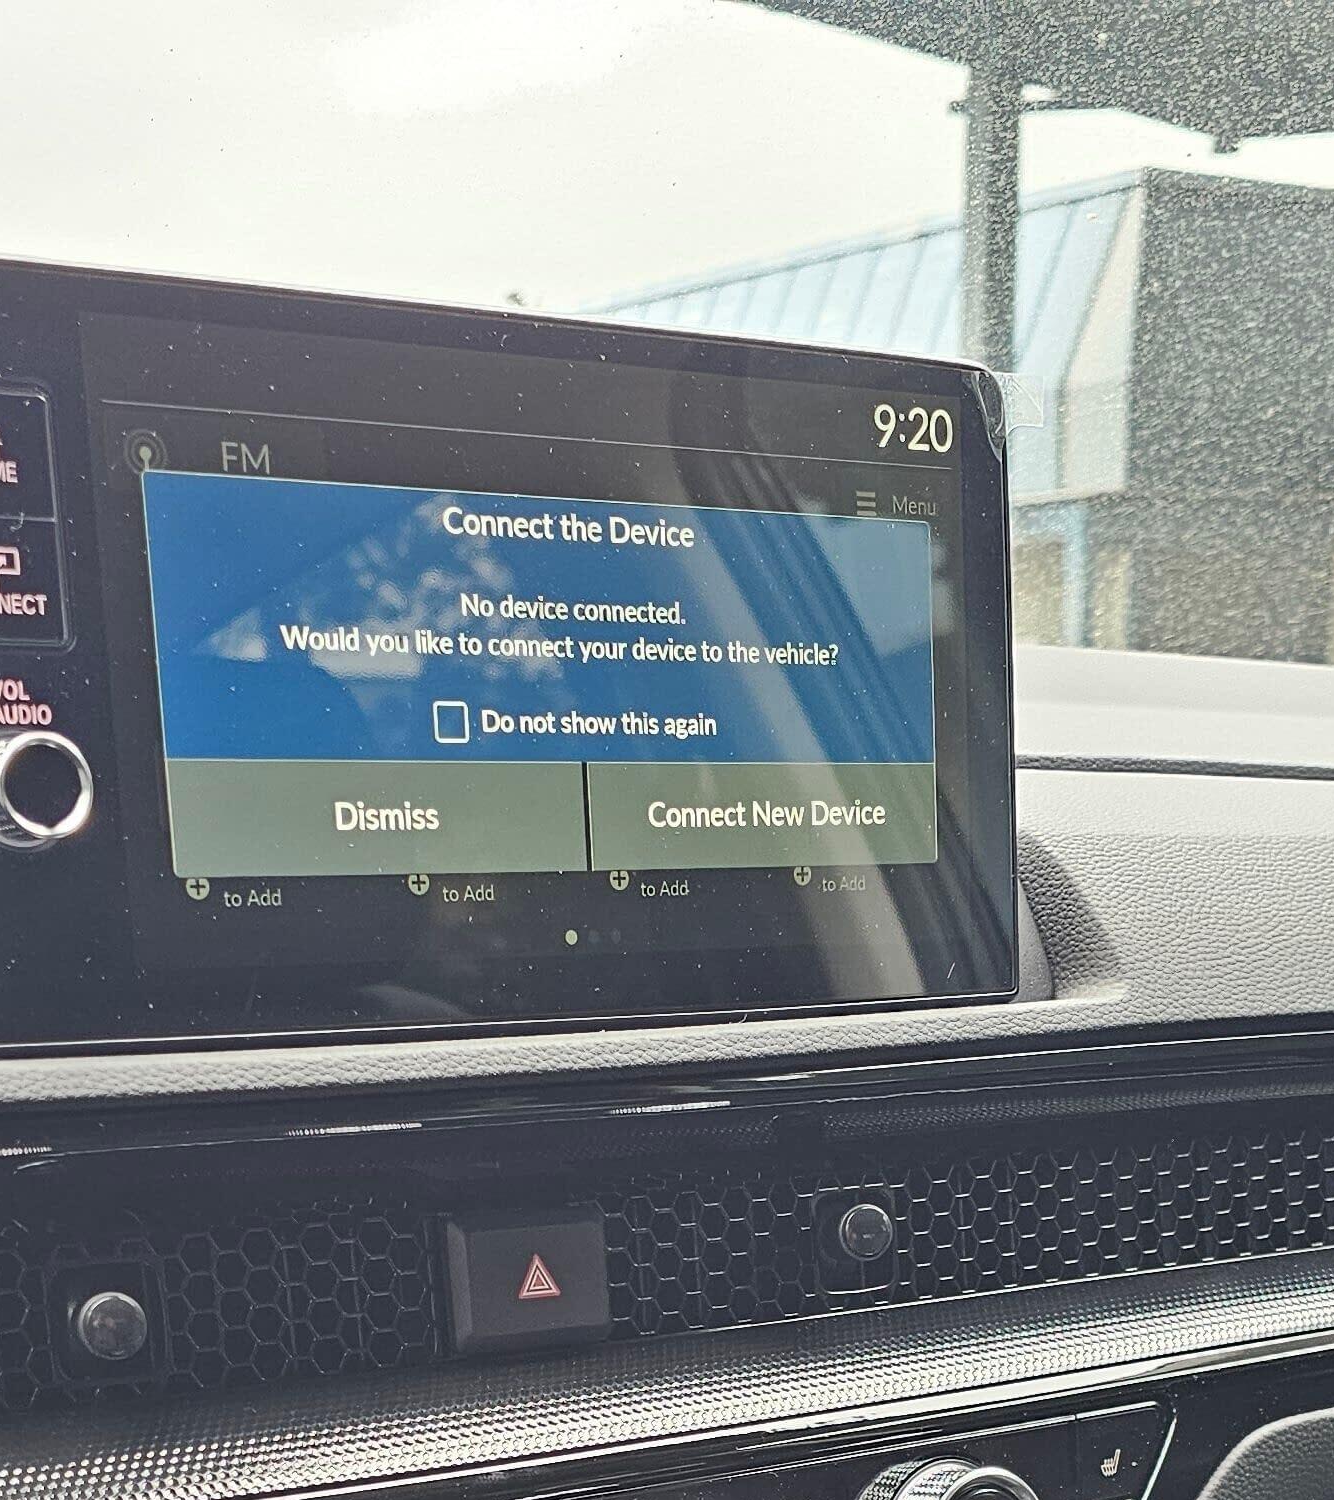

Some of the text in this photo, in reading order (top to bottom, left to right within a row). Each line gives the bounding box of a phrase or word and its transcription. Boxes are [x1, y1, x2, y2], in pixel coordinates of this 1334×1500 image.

[873, 403, 954, 453] 9:20
[220, 441, 271, 474] FM
[891, 495, 938, 516] Menu
[442, 506, 696, 548] Connect the Device
[460, 592, 687, 625] No device connected.
[279, 624, 840, 667] Would you like to connect your device to the vehicle?
[481, 709, 717, 740] Do not show this again
[334, 800, 440, 831] Dismiss
[647, 799, 886, 829] Connect New Device
[223, 889, 282, 907] to Add
[442, 885, 495, 902] to Add
[640, 879, 689, 897] to Add
[822, 875, 866, 893] to Add
